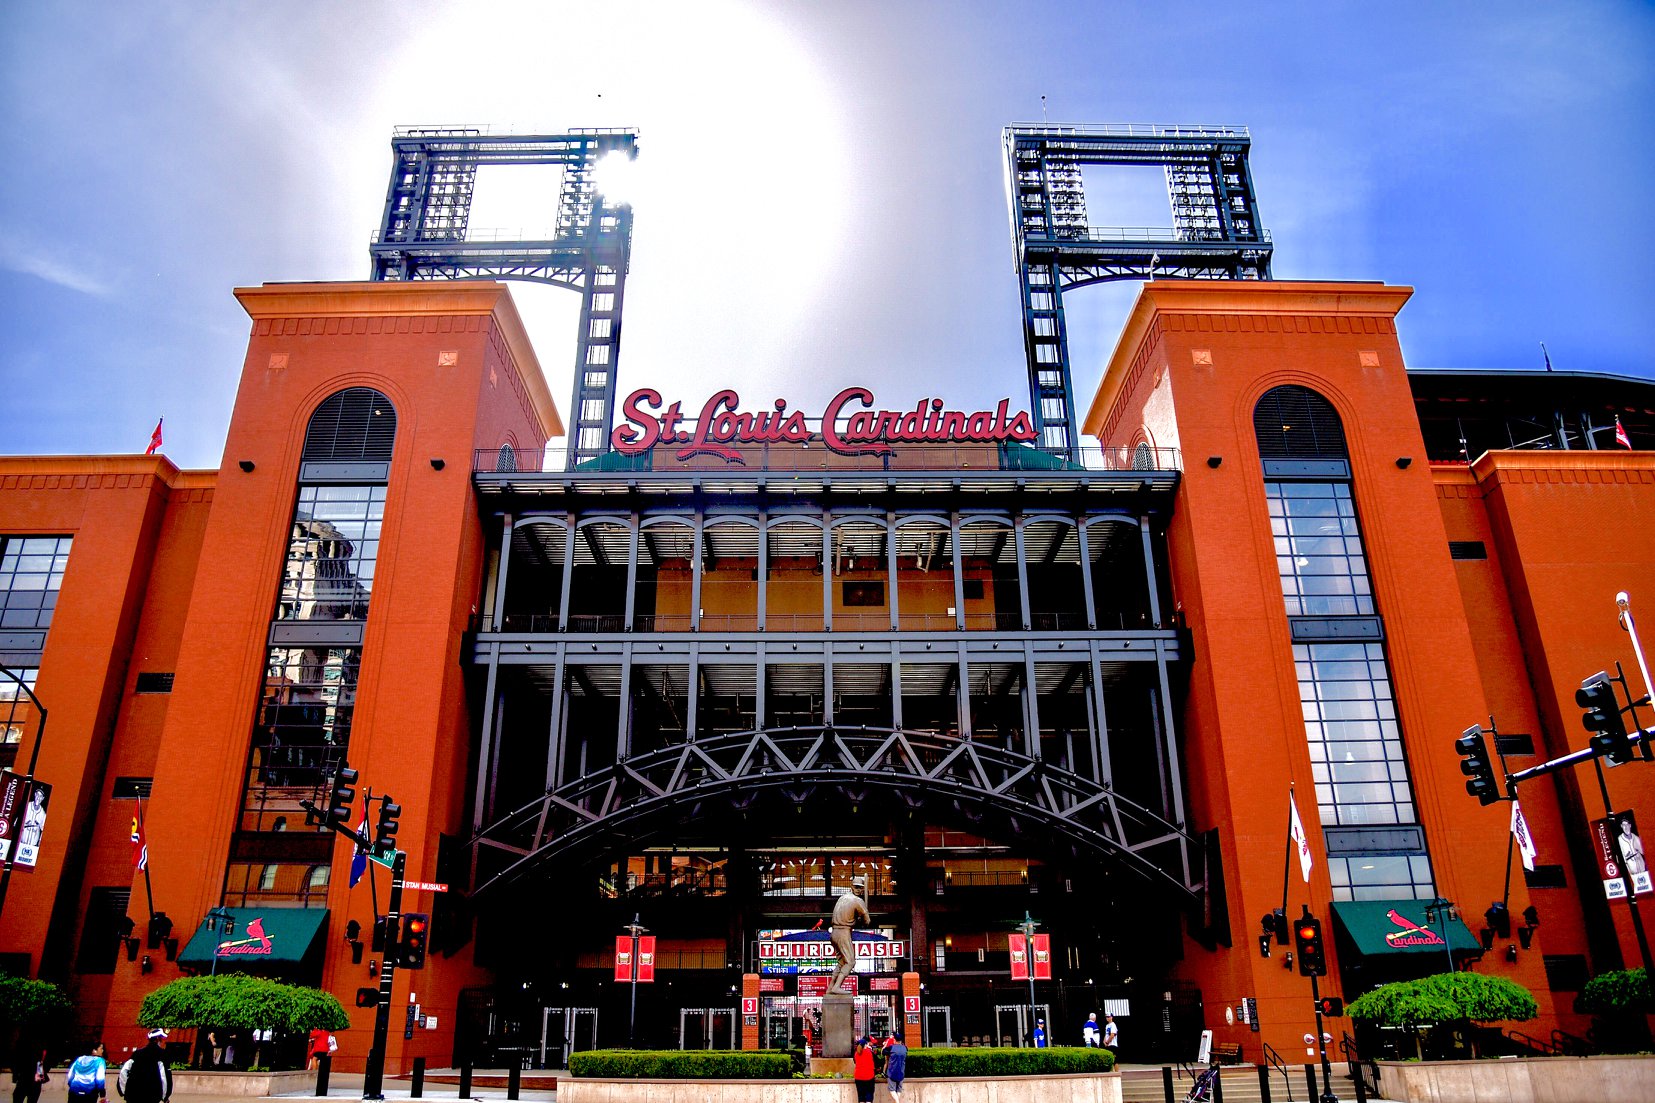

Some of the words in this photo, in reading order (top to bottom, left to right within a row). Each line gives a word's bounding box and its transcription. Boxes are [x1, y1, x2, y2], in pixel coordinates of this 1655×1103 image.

[612, 387, 690, 455] St.
[676, 388, 814, 466] Louis
[821, 386, 1040, 457] Cardinals
[6, 778, 18, 811] LEGEND
[421, 882, 442, 892] MUSIAL
[1385, 933, 1446, 948] Cardinals
[214, 941, 272, 957] Cardinals
[763, 944, 835, 956] THIRD
[855, 944, 901, 955] ASE
[747, 1001, 753, 1012] 3
[909, 999, 916, 1010] 3
